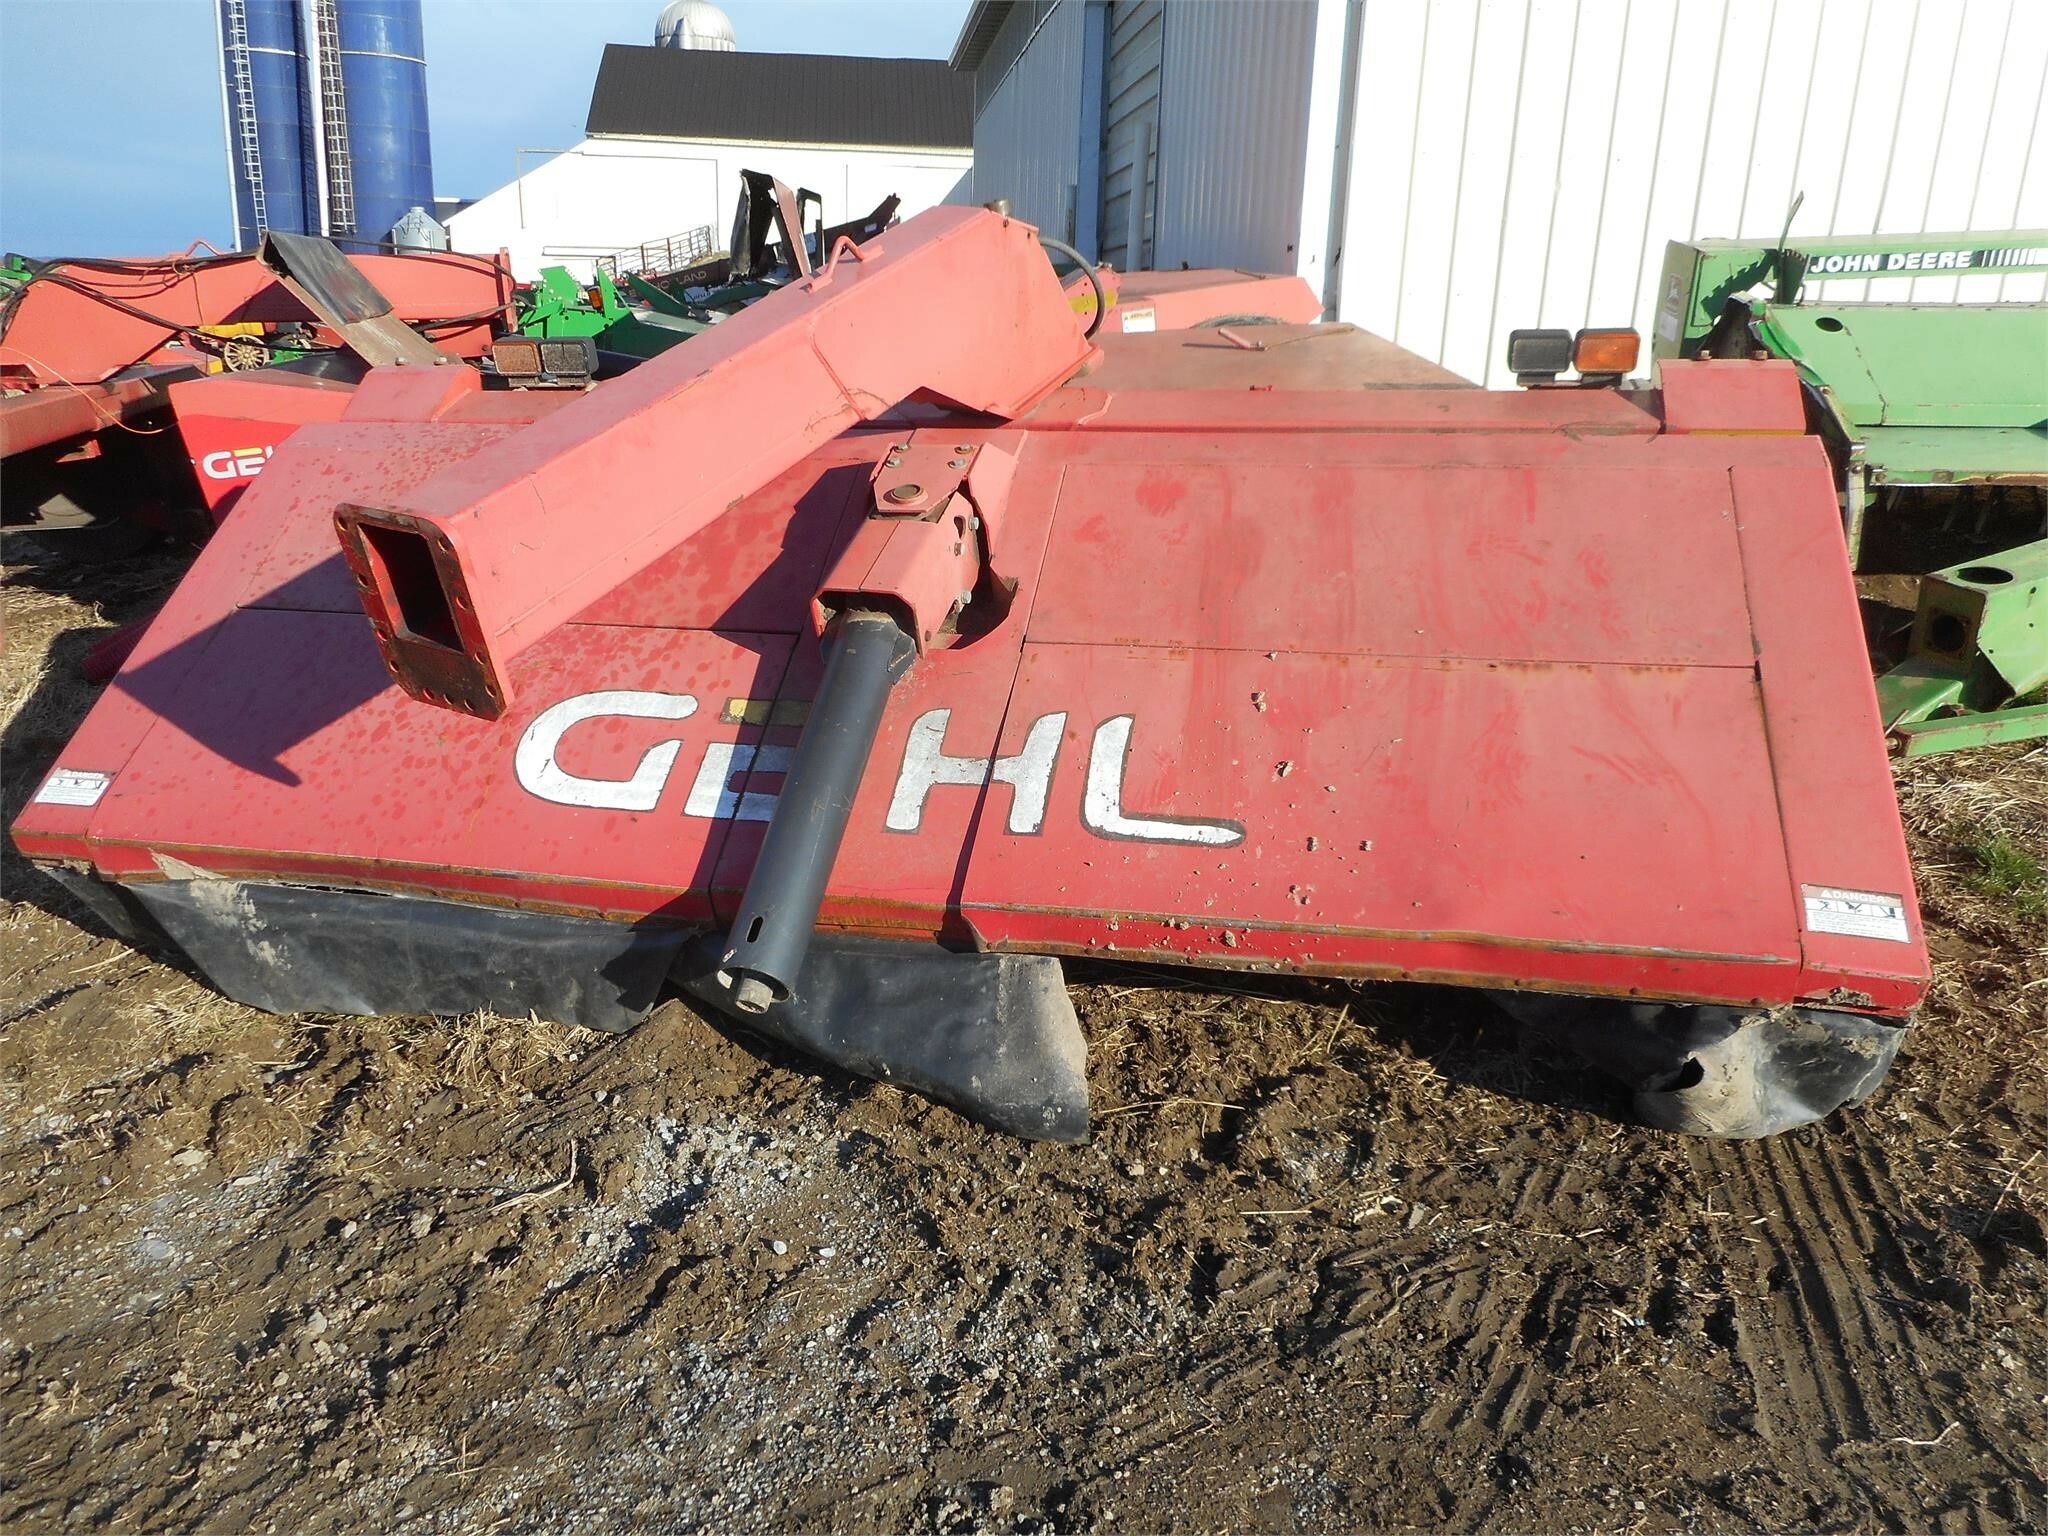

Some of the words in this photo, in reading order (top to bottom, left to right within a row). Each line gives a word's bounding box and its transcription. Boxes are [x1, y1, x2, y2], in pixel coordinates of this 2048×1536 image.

[1810, 254, 1881, 273] JOHN
[1887, 250, 1973, 271] DEERE
[514, 690, 1246, 847] GEHL
